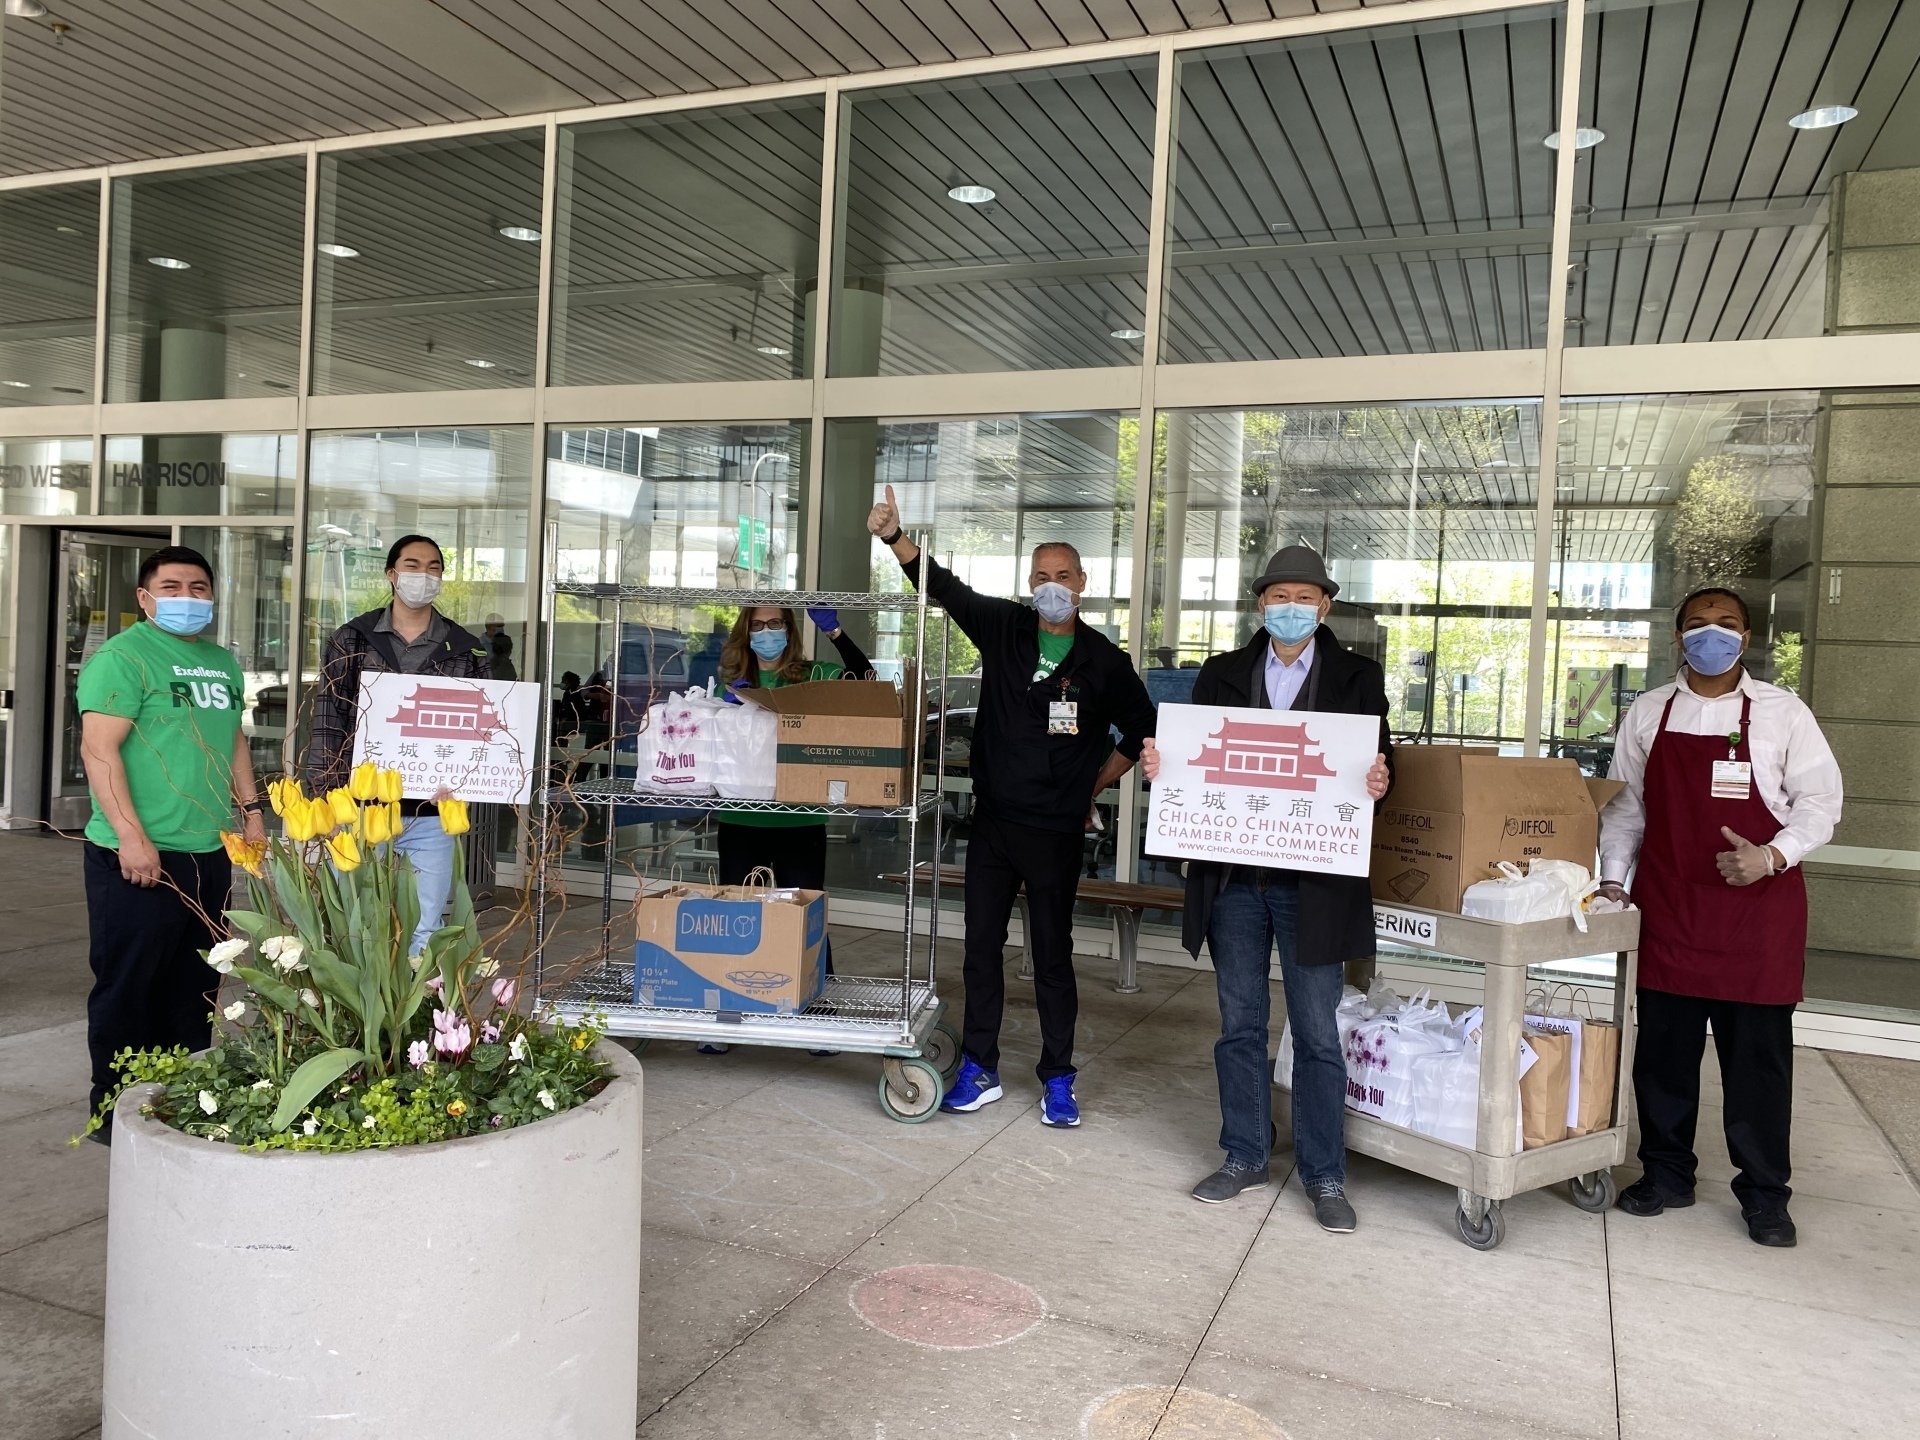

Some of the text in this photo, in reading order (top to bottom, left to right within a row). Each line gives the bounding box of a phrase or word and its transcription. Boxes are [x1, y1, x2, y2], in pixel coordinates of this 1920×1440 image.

[30, 464, 90, 488] WEST
[169, 681, 246, 711] RUSH
[782, 720, 801, 729] 1120
[809, 747, 877, 757] CELTIC TOWEL
[368, 759, 428, 772] HICAGO
[429, 775, 446, 785] OF
[450, 775, 524, 788] COMMERCE
[1160, 787, 1360, 822] 芝城華商會
[1158, 808, 1360, 840] CHICAGO CHINATOWN
[1157, 824, 1359, 855] CHAMBER OF COMMERCE
[1401, 836, 1419, 845] 8540
[1177, 842, 1334, 864] WWW.CHICAGOCHINATOWN.ORG
[1394, 846, 1414, 855] Steam
[1415, 849, 1431, 857] Table
[1436, 852, 1453, 861] Deep
[1523, 847, 1541, 855] 8540
[1516, 860, 1529, 868] Stea
[681, 912, 730, 937] DARNEL
[1374, 911, 1431, 938] ERING
[641, 968, 653, 976] 10
[661, 978, 678, 986] Plate
